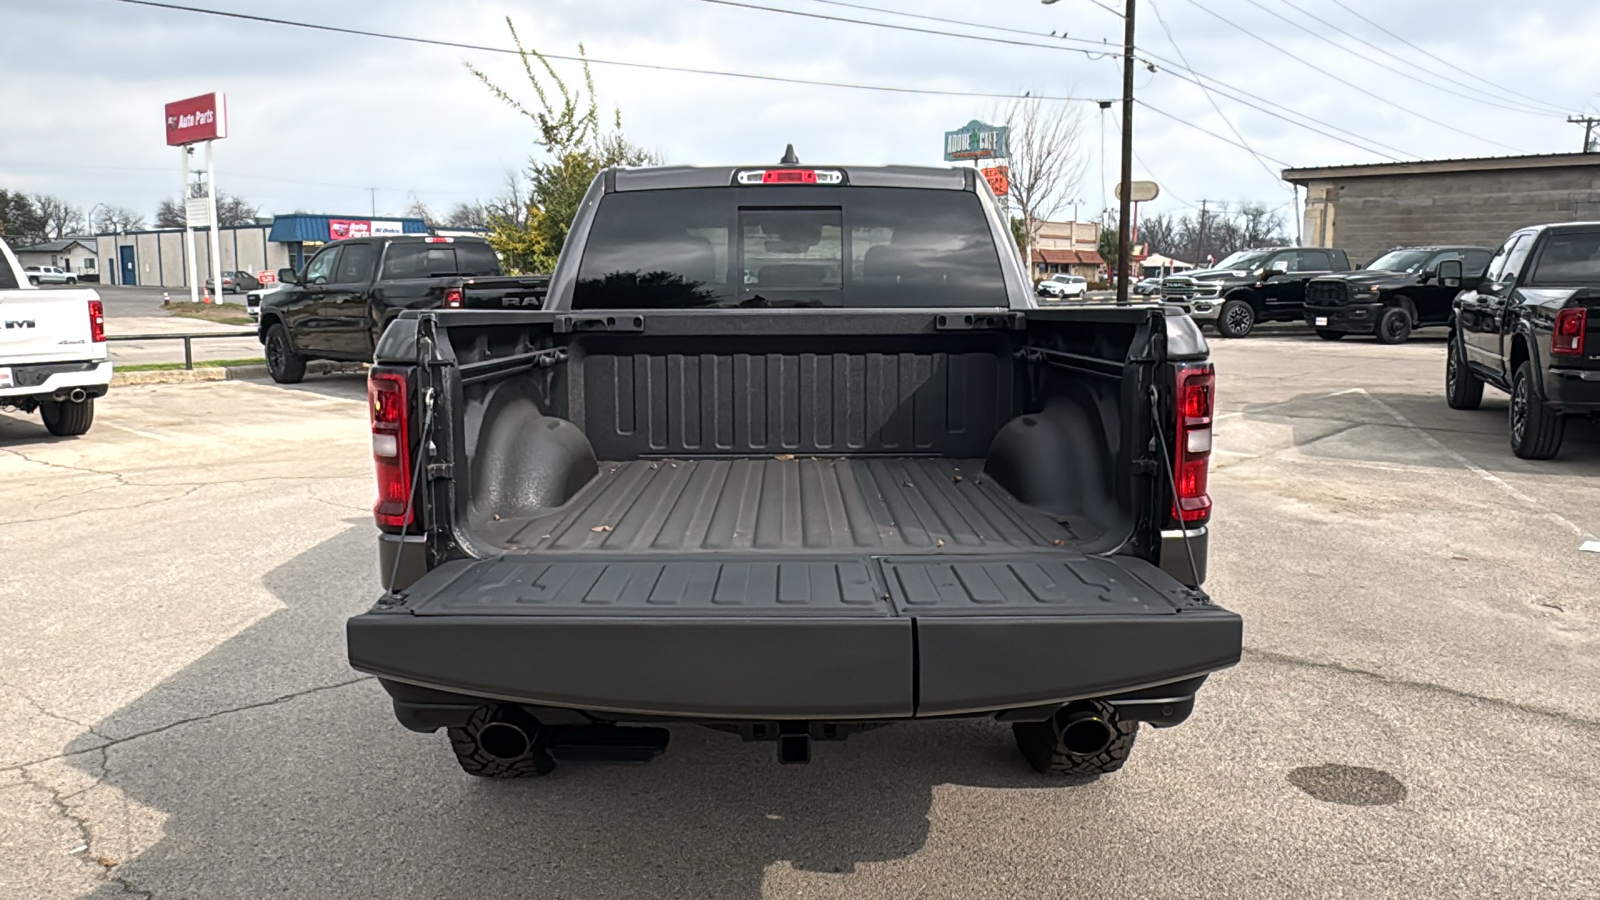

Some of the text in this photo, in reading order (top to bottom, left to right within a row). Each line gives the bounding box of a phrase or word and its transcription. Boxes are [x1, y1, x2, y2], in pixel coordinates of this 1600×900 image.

[178, 114, 194, 129] Auto
[195, 109, 214, 126] Parts
[947, 132, 972, 154] ADOBE
[349, 223, 367, 231] Auto
[349, 230, 370, 238] Parts
